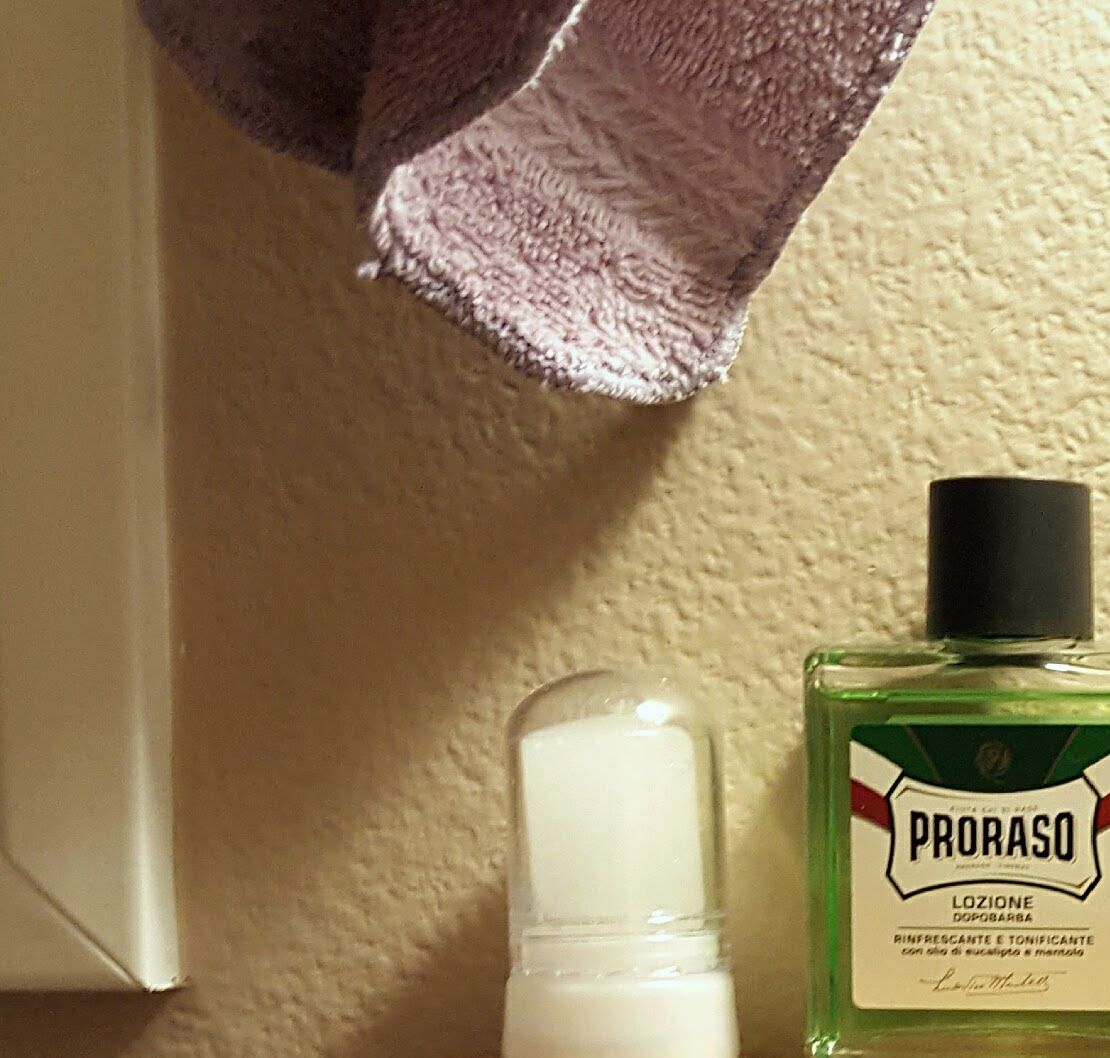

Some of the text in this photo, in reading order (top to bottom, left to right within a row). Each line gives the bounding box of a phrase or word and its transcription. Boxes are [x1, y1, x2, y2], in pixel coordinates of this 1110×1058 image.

[909, 810, 1075, 862] PRORASO
[952, 895, 1034, 909] LOZIONE
[953, 912, 1033, 922] DOPOBARBA
[893, 934, 1095, 946] RINFRESCANTE E TONIFICANTE
[901, 947, 923, 956] con
[926, 945, 948, 956] olio
[951, 946, 962, 956] di
[965, 946, 1021, 958] eucalipto
[1034, 947, 1085, 957] mentolo
